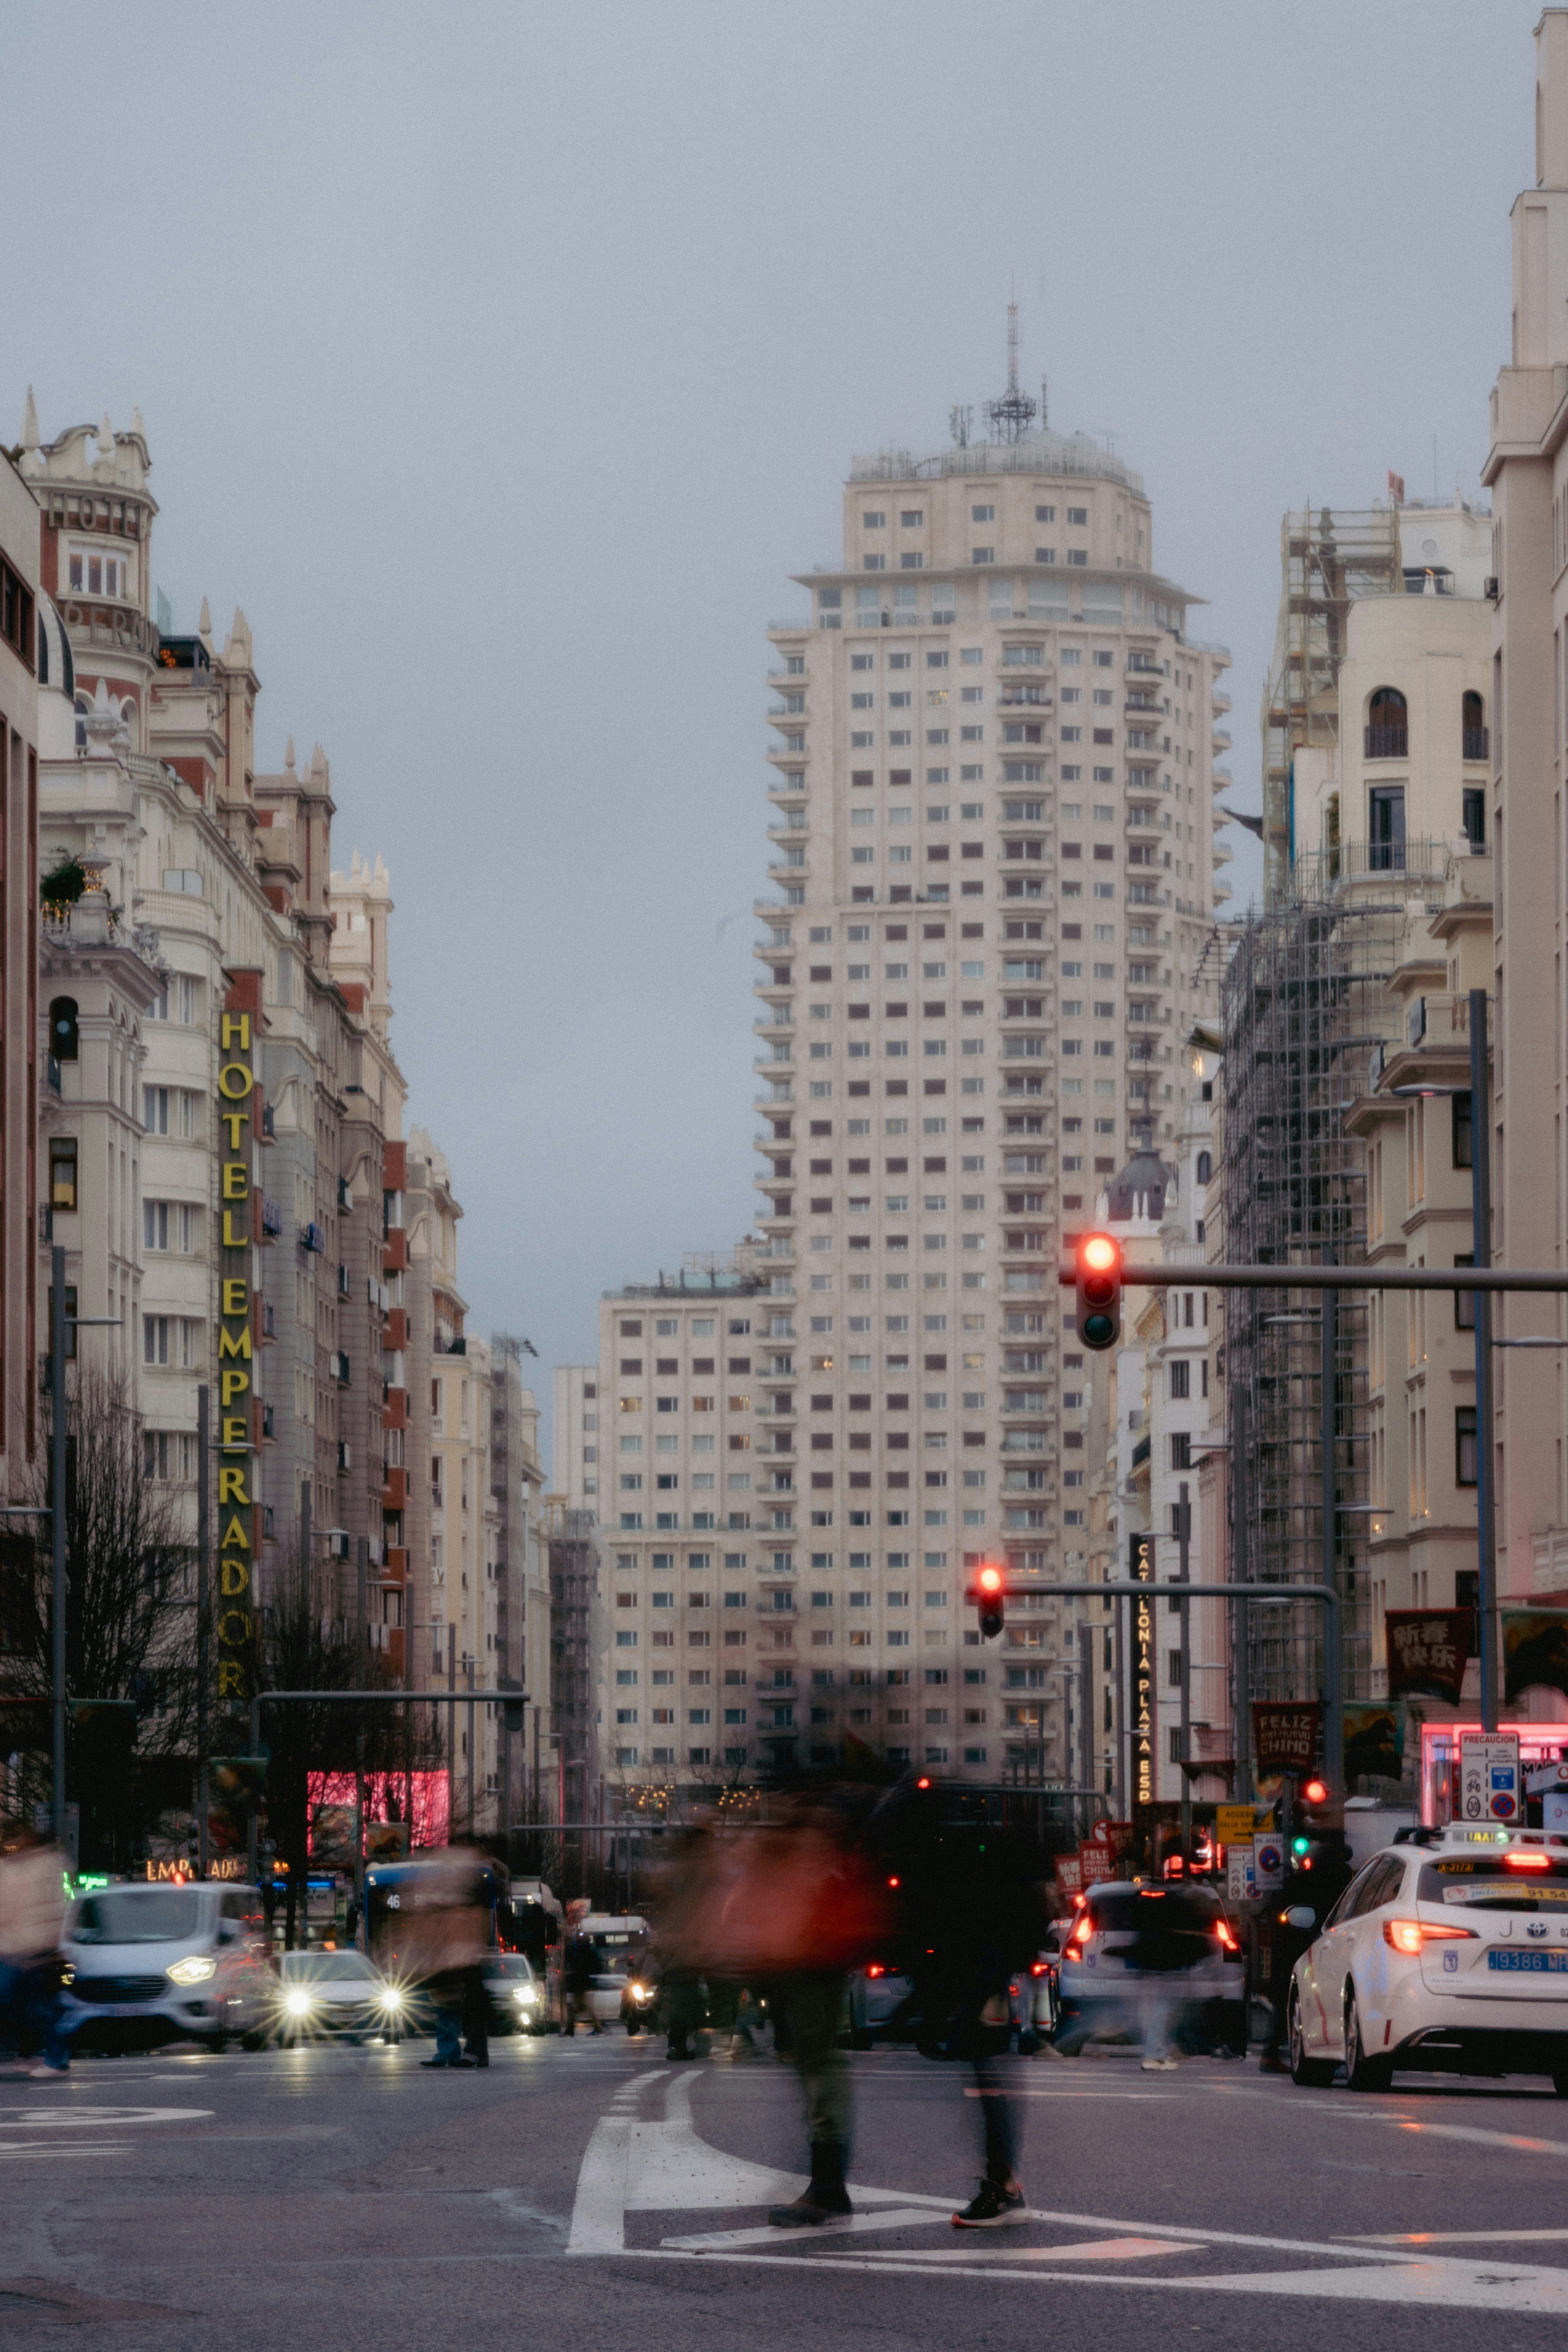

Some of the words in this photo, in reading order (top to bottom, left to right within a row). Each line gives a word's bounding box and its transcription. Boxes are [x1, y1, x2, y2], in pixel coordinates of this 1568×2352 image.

[219, 1013, 253, 1246] HOTEL
[218, 1279, 253, 1697] EMPERADOR
[1138, 1543, 1150, 1669] CATLONIA
[1139, 1679, 1151, 1751] PLAZA
[1260, 1714, 1311, 1730] FELIZ
[1260, 1740, 1309, 1755] CHINO
[1083, 1850, 1109, 1860] FELI
[387, 1894, 400, 1909] 46
[1550, 1890, 1568, 1899] 54
[1500, 1952, 1542, 1970] 9386
